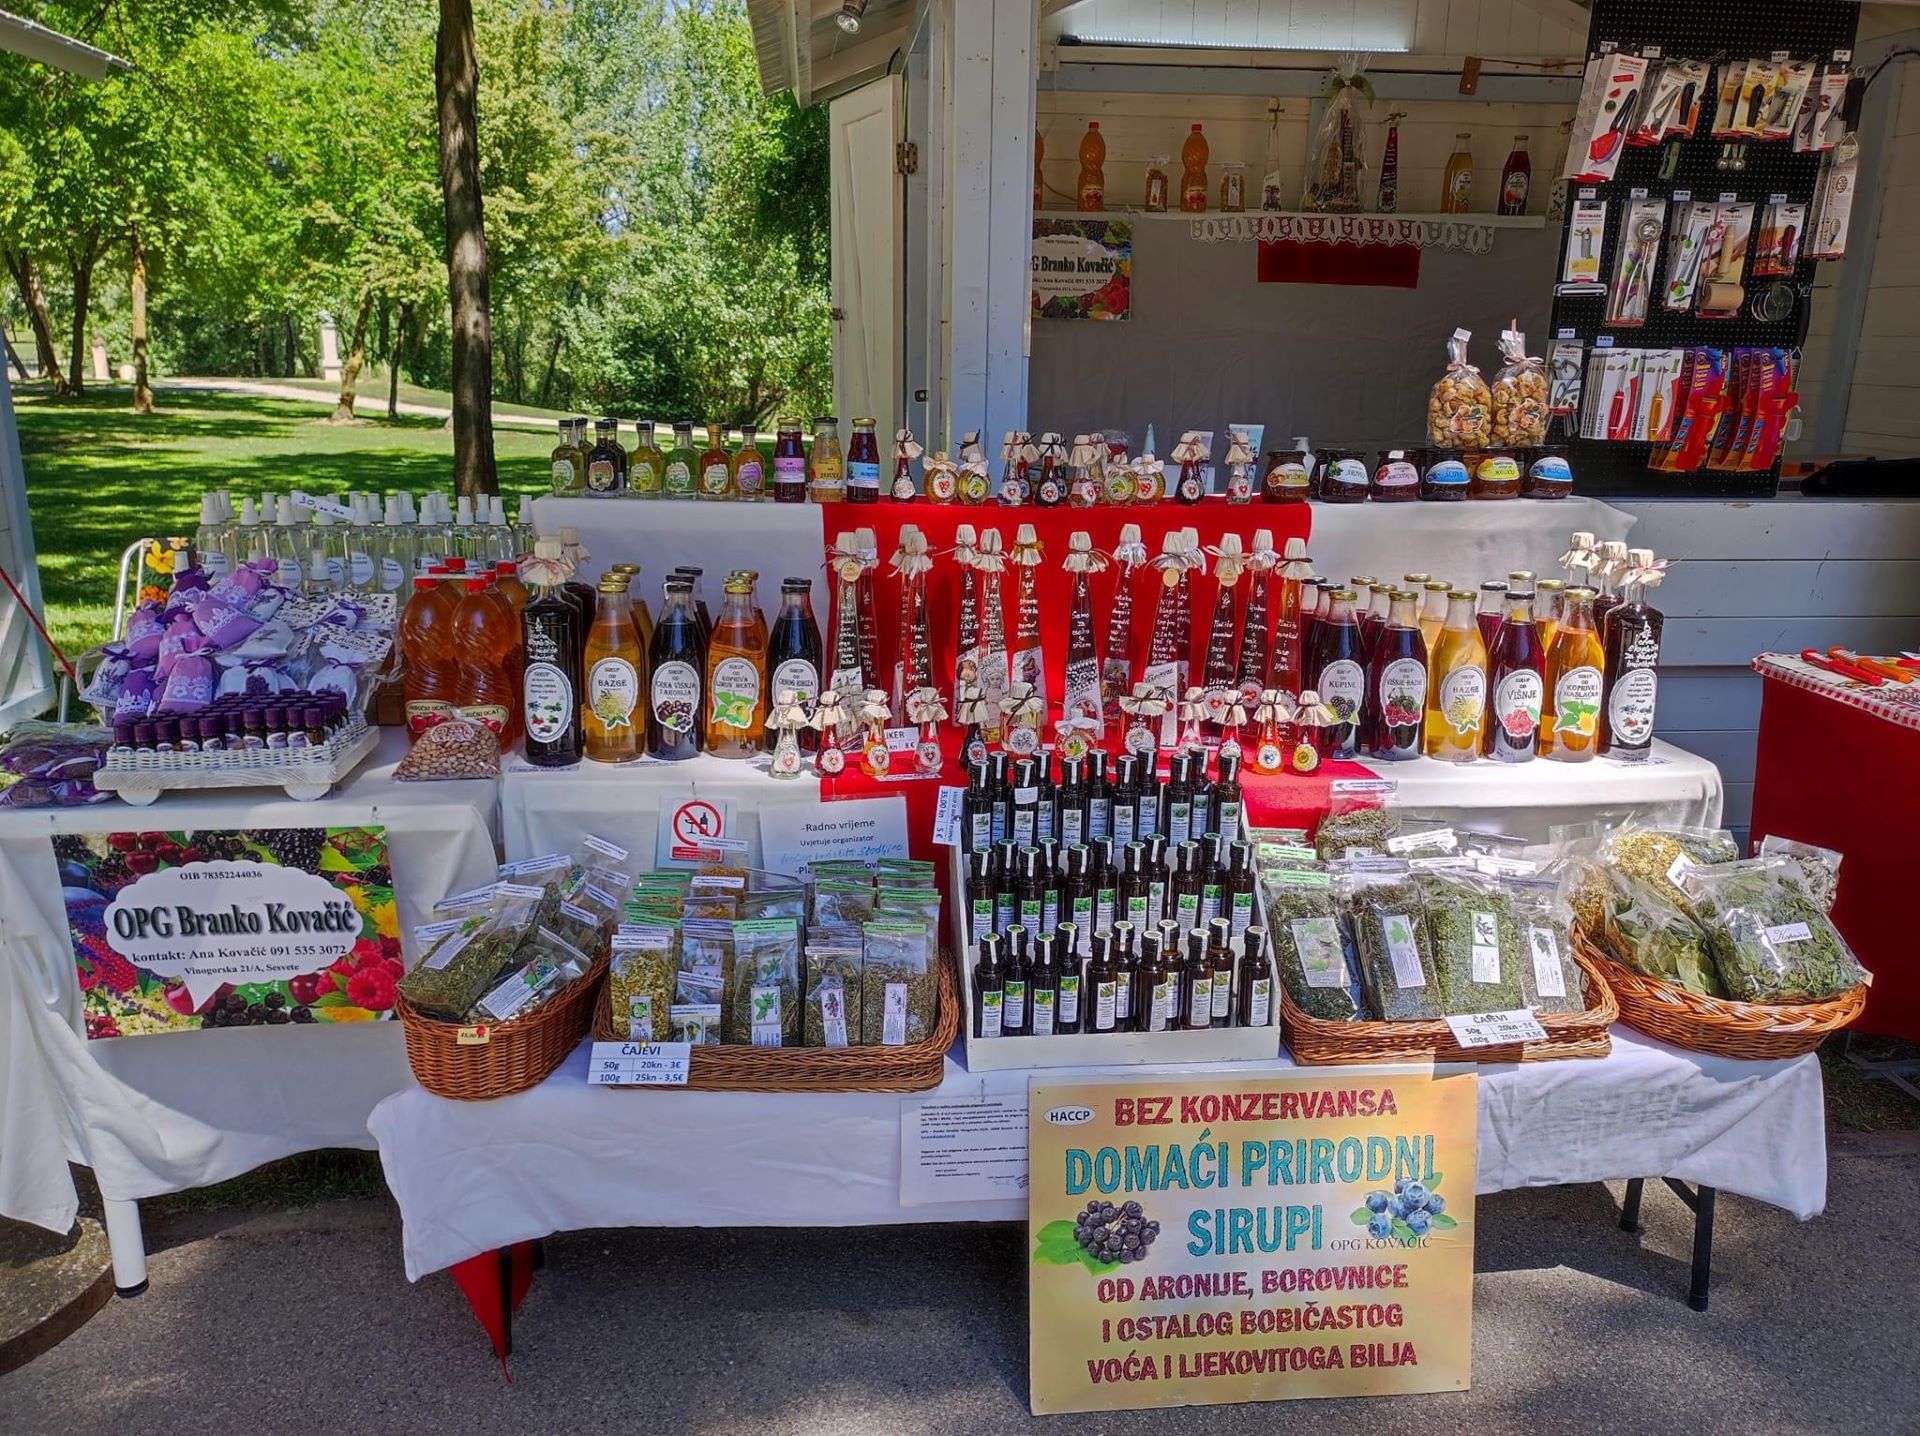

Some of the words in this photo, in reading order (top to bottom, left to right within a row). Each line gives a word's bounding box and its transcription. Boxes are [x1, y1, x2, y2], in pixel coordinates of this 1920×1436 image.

[1041, 256, 1076, 273] Branko
[598, 679, 627, 687] BAZGE
[1328, 681, 1357, 689] KUPINE
[1507, 688, 1538, 700] VIŠNJE
[886, 731, 905, 739] IKER
[838, 819, 876, 830] vrijeme
[800, 838, 831, 848] Uvjetuje
[831, 835, 875, 845] organizator
[180, 871, 200, 881] OIB
[202, 869, 263, 880] 78352244036
[113, 905, 172, 939] OPG
[175, 904, 264, 937] Branko
[267, 900, 356, 934] Kovačić
[132, 951, 186, 963] kontakt:
[189, 949, 215, 960] Ana
[217, 946, 267, 959] Kovačić
[269, 946, 293, 956] 091
[294, 945, 317, 956] 535
[318, 944, 347, 956] 3072
[184, 965, 239, 977] Vinogorska
[239, 964, 265, 975] 21/A,
[265, 963, 300, 973] Sesvete
[1473, 1014, 1509, 1024] ČAJEVI
[621, 1044, 661, 1055] ČAJEVI
[604, 1061, 620, 1070] 50g
[641, 1061, 663, 1069] 20kn
[669, 1061, 681, 1069] 3€
[600, 1074, 621, 1083] 100g
[635, 1073, 657, 1082] 25kn
[664, 1073, 684, 1082] 3,5€
[1115, 1096, 1173, 1127] BEZ
[1180, 1089, 1398, 1124] KONZERVANSA
[1049, 1109, 1091, 1124] HACCP
[1065, 1129, 1229, 1195] DOMAĆI
[1241, 1134, 1435, 1187] PRIRODNI
[1187, 1204, 1322, 1257] SIRUPI
[1330, 1238, 1361, 1251] OPG
[1364, 1234, 1431, 1251] KOVAČIĆ
[1097, 1278, 1135, 1303] OD
[1139, 1271, 1254, 1301] ARONIJE,
[1261, 1264, 1410, 1294] BOROVNICE
[1102, 1319, 1111, 1343] I
[1117, 1311, 1234, 1342] OSTALOG
[1240, 1302, 1403, 1335] BOBIČASTOG
[1087, 1350, 1159, 1384] VOĆA
[1164, 1356, 1172, 1379] I
[1179, 1346, 1343, 1377] LJEKOVITOGA
[1349, 1341, 1418, 1368] BILJA
